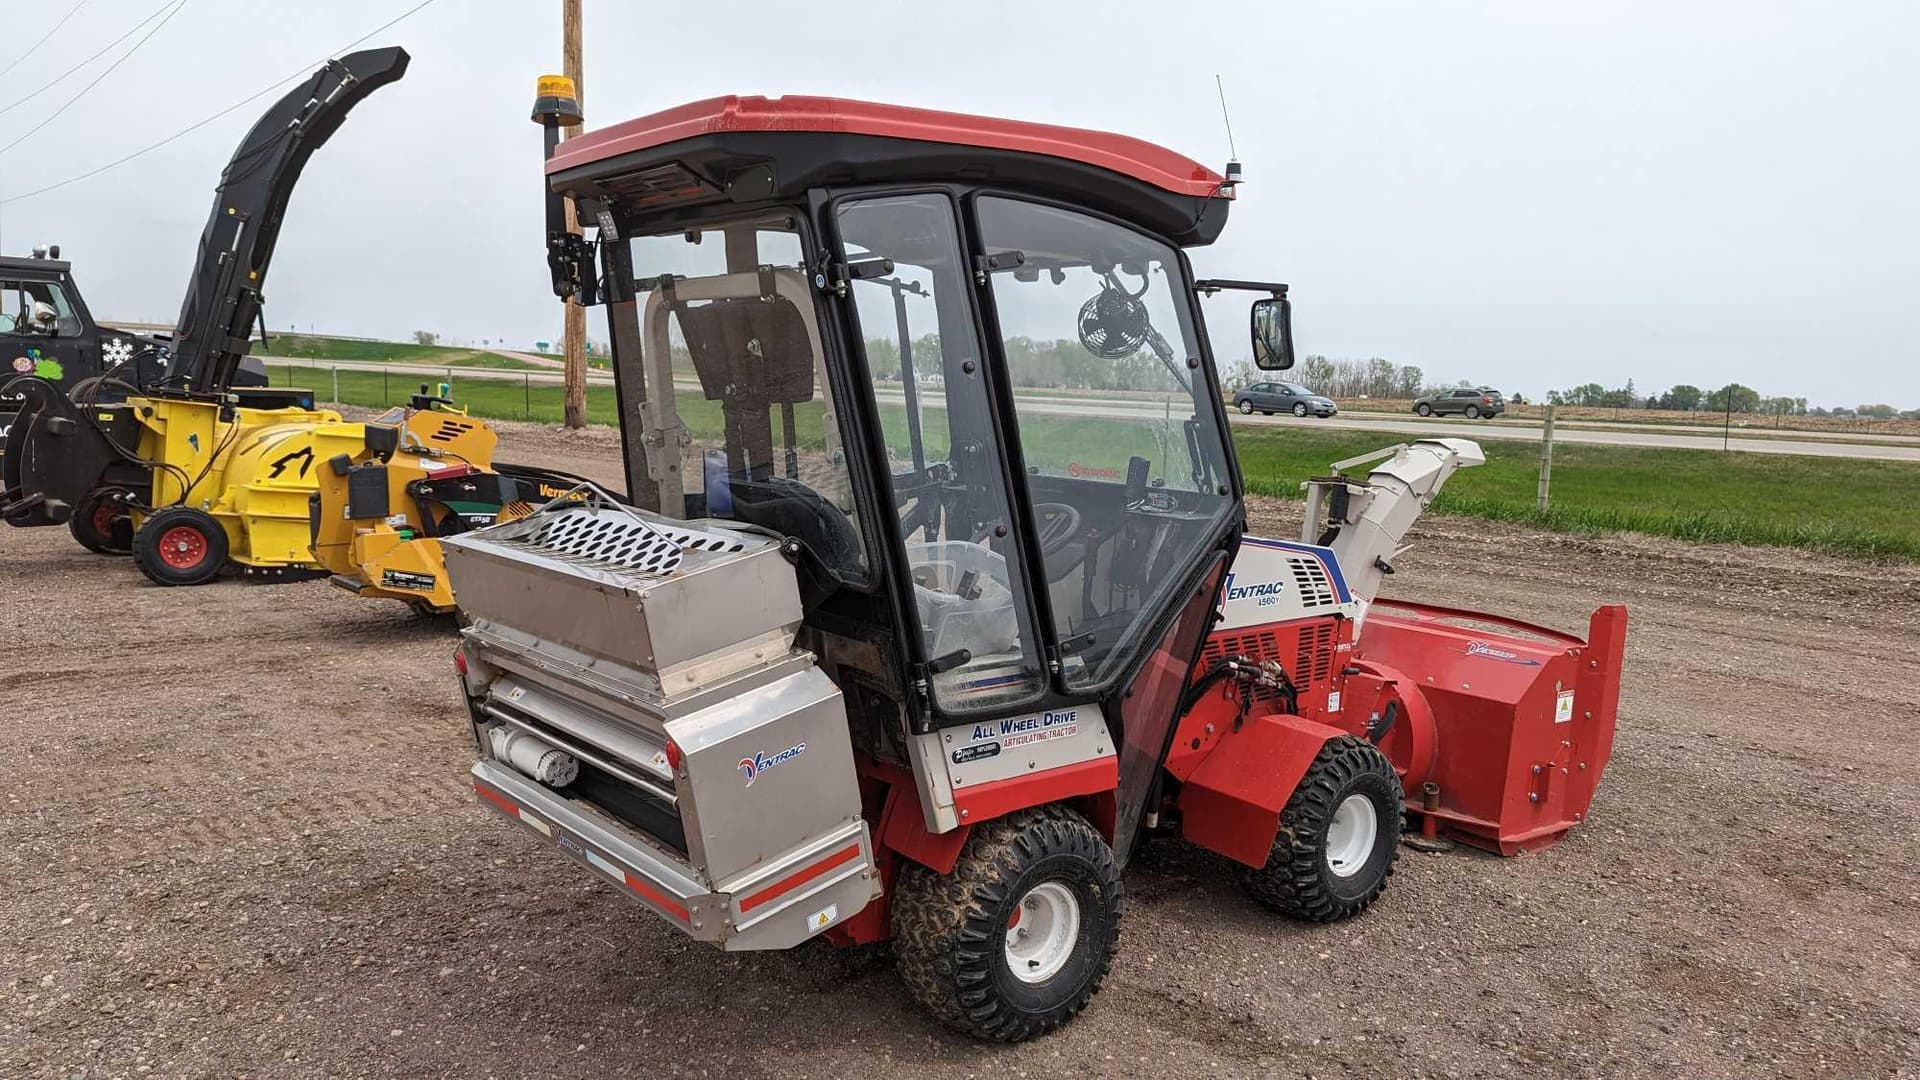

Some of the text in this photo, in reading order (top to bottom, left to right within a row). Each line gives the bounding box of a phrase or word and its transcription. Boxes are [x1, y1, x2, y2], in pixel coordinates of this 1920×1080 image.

[972, 711, 1077, 741] ALL WHEEL DRIVE
[1003, 725, 1078, 748] ARTICULATING TRACTOR
[737, 742, 806, 787] VENTRAC
